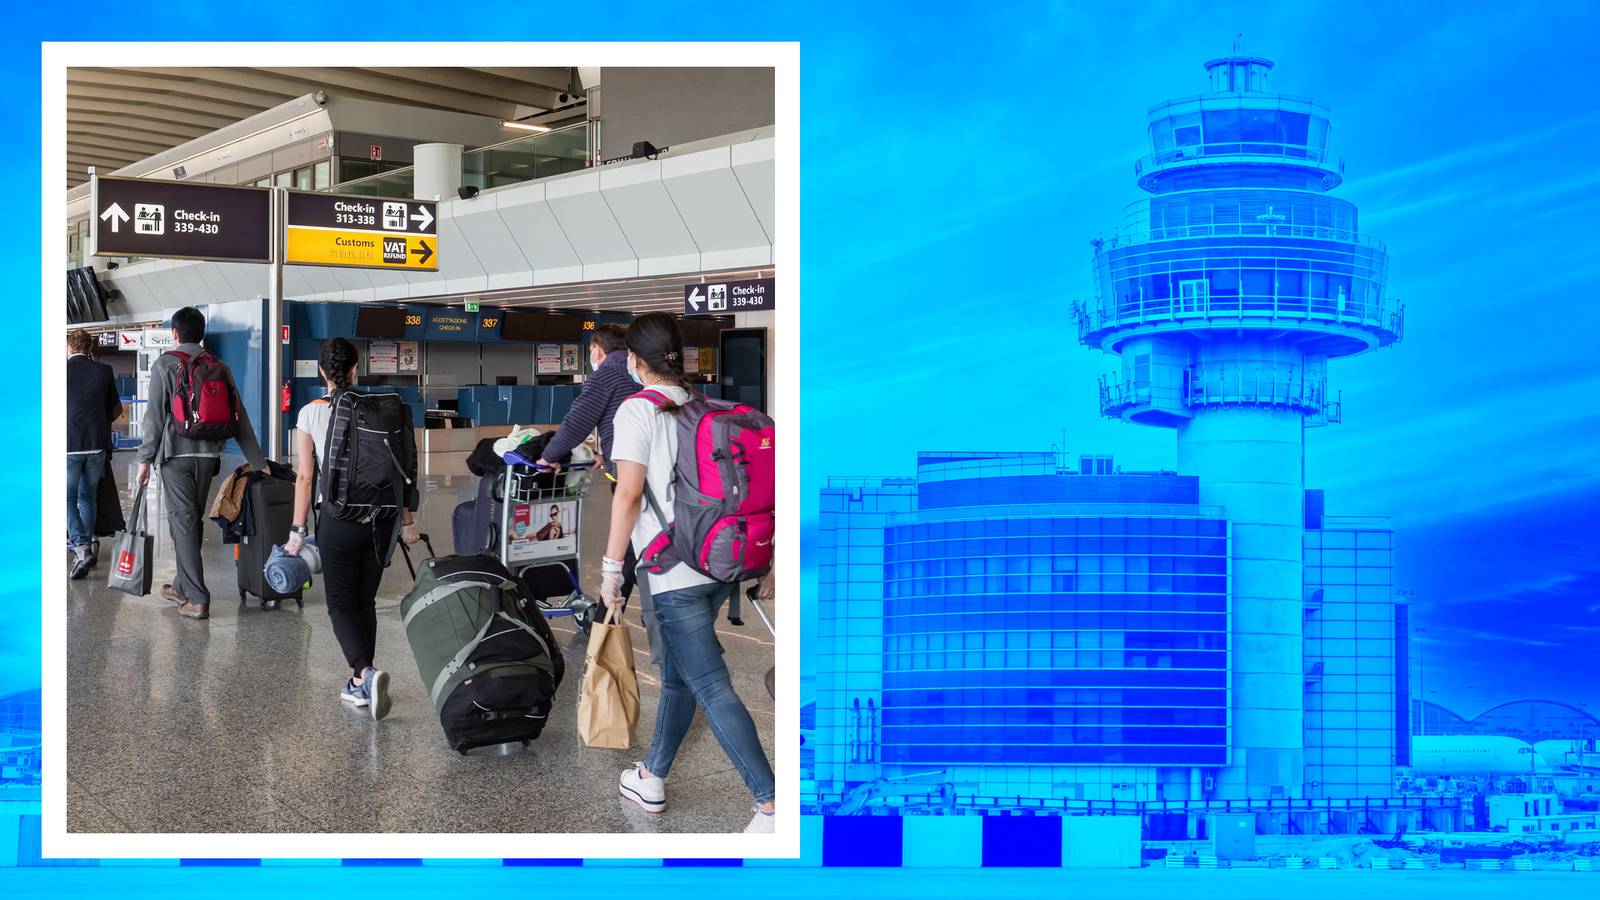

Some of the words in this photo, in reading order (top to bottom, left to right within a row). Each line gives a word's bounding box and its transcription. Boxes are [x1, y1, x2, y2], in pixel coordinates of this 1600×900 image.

[334, 201, 375, 214] Check-in
[174, 209, 220, 222] Check-in
[336, 213, 375, 225] 313-338
[174, 222, 219, 234] 339-430
[335, 237, 375, 248] Customs
[384, 241, 406, 253] VAT
[384, 252, 406, 260] REFUND
[732, 284, 765, 296] Check-in
[732, 295, 764, 307] 339-430
[404, 315, 421, 325] 338
[482, 318, 498, 328] 337
